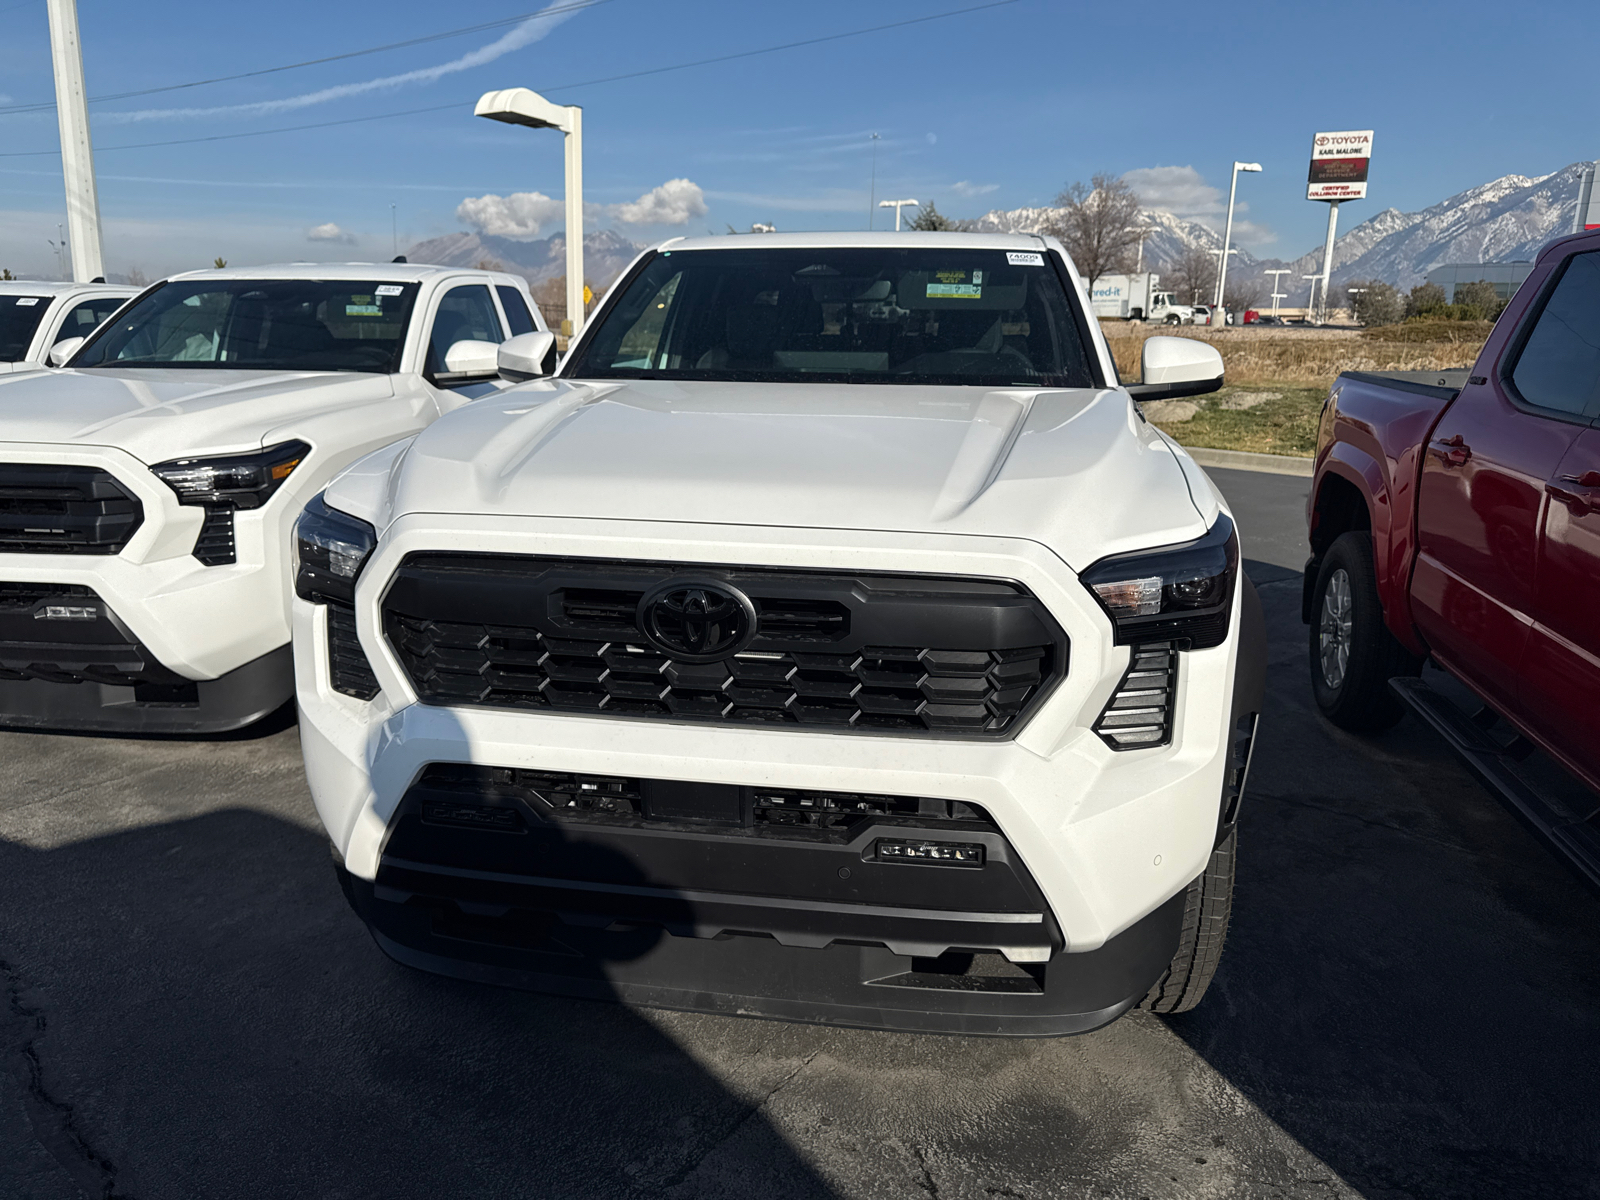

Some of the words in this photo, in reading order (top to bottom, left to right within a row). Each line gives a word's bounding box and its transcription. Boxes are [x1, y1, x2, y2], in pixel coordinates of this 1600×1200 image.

[1330, 135, 1369, 145] TOYOTA
[1319, 148, 1335, 156] KARL
[1336, 147, 1363, 155] MALONE
